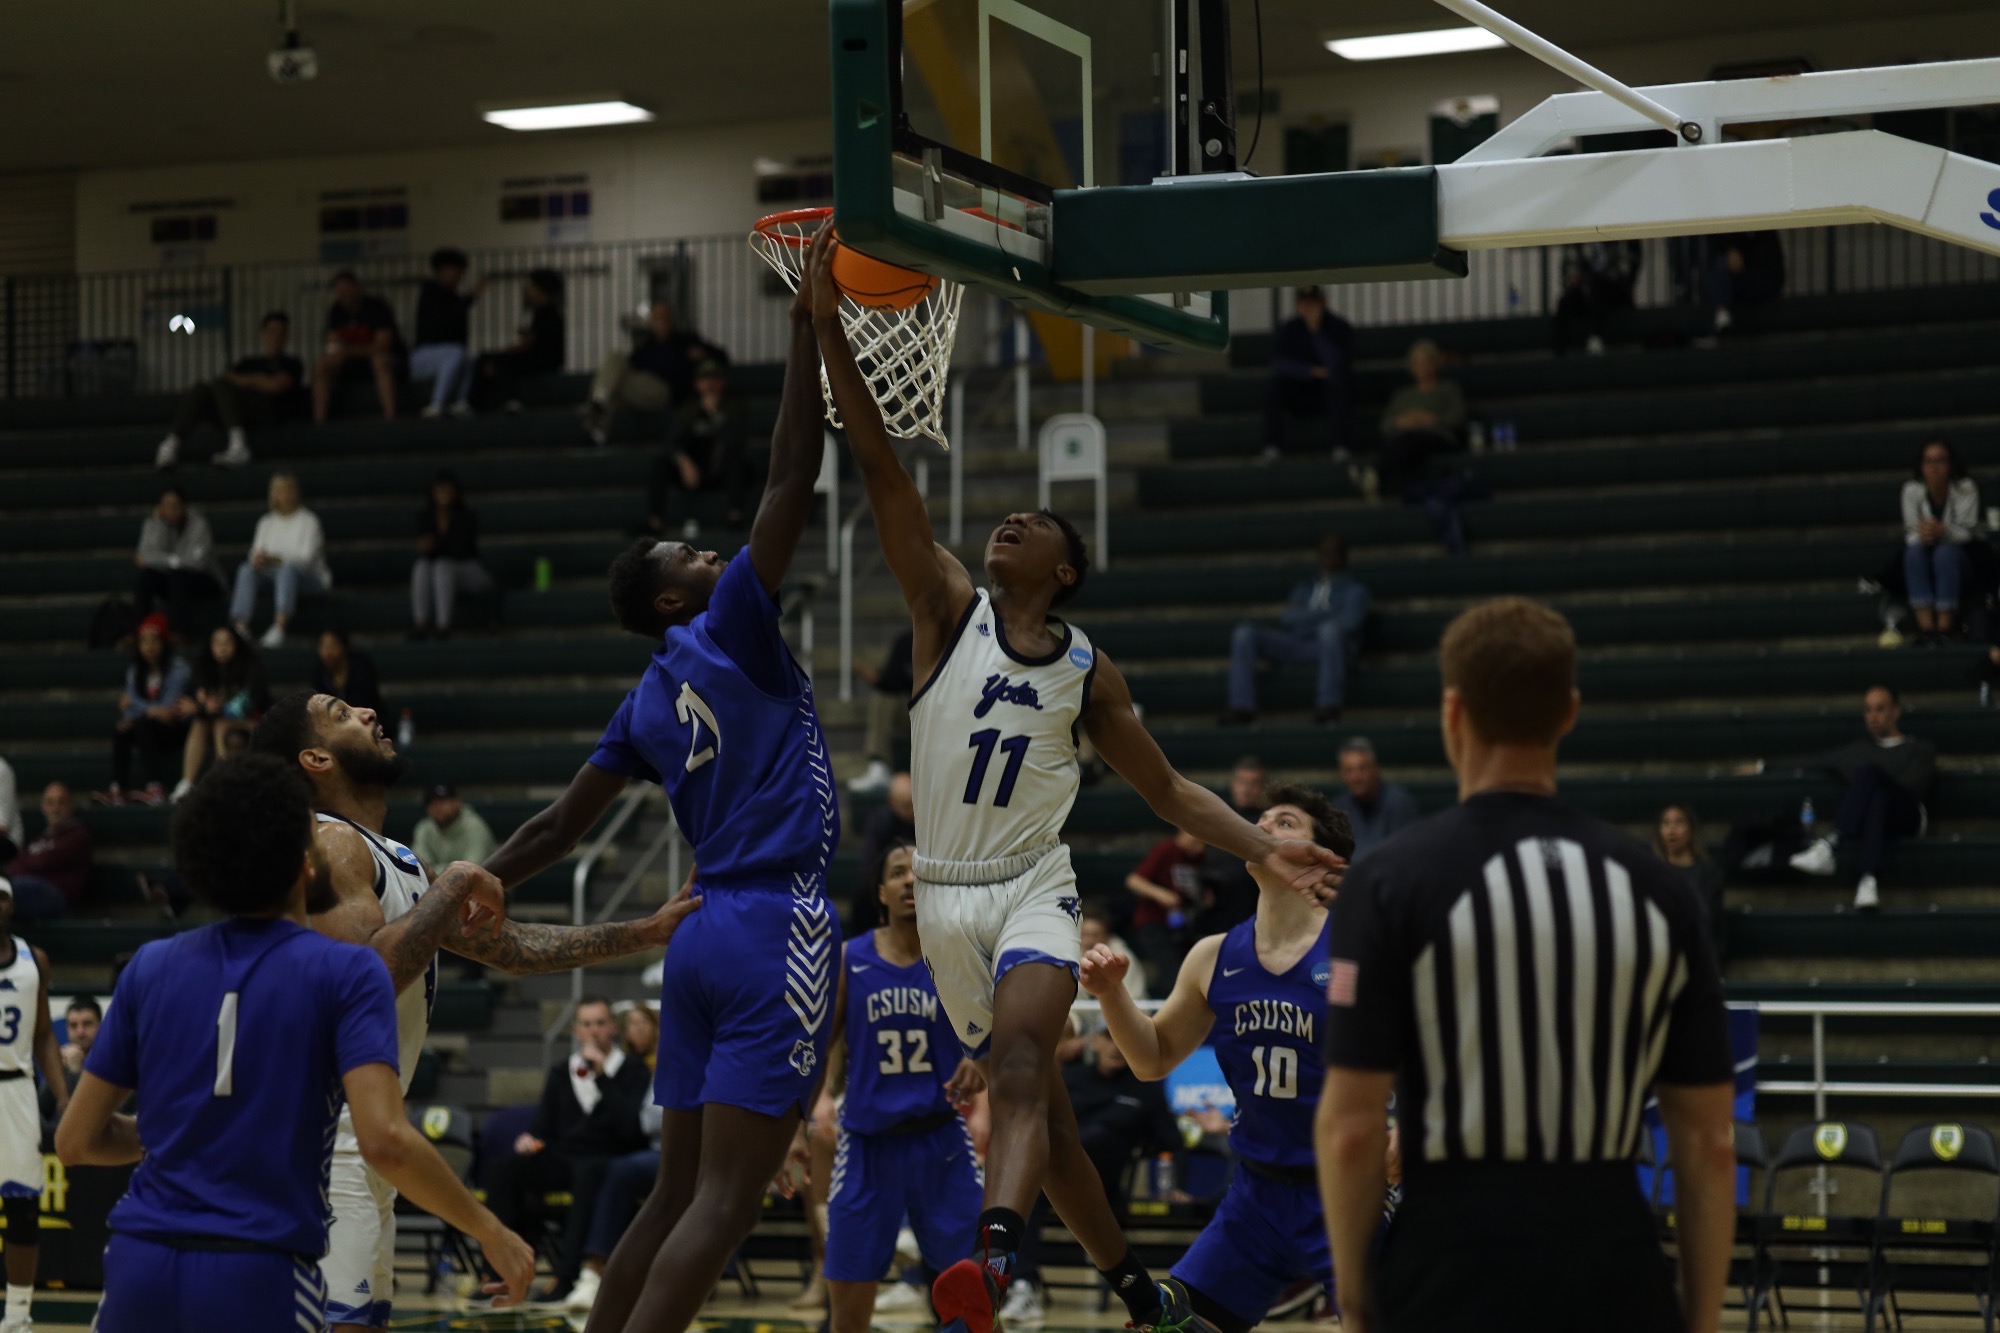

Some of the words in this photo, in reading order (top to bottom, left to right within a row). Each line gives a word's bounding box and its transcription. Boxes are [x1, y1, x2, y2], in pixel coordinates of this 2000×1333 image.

[963, 728, 1031, 808] 11
[0, 1007, 21, 1044] 3
[867, 986, 938, 1023] CSUSM
[1234, 998, 1313, 1044] CSUSM
[213, 991, 239, 1097] 1
[877, 1028, 933, 1075] 32
[1251, 1045, 1298, 1099] 10
